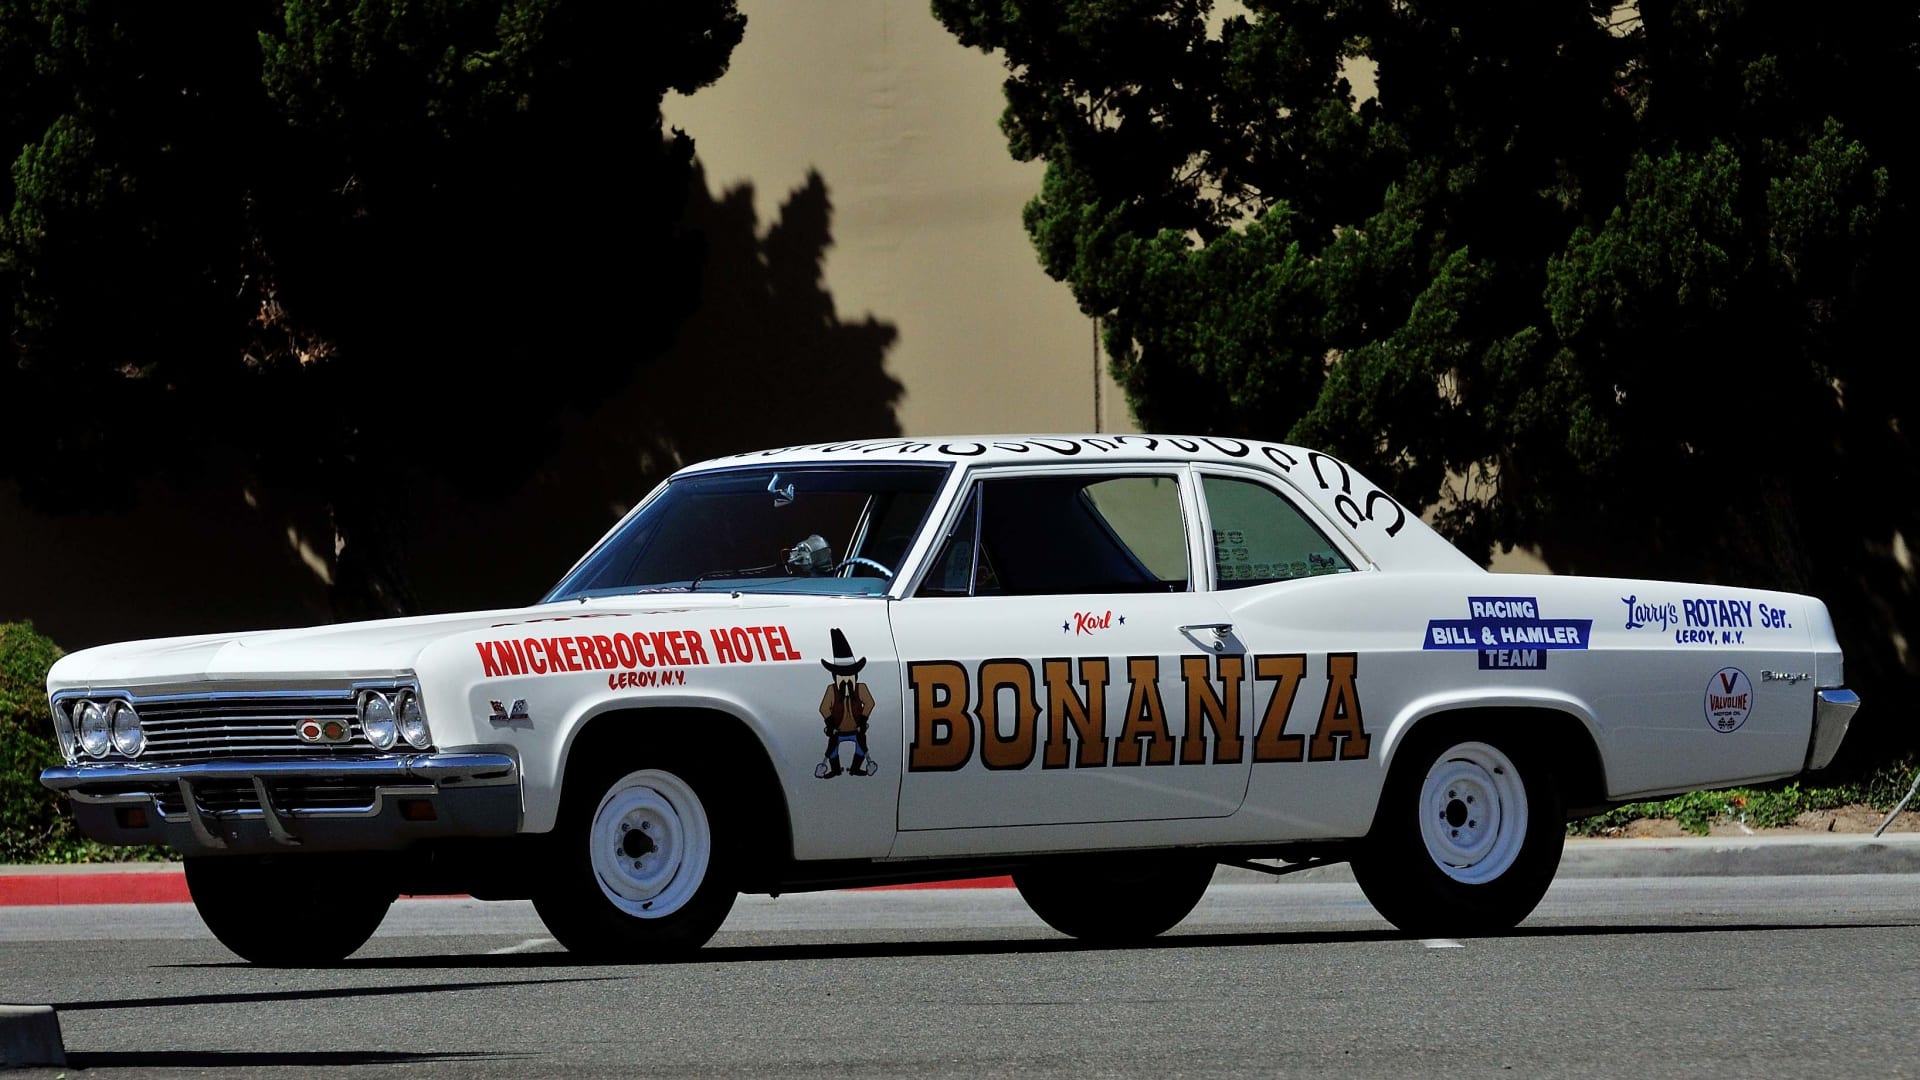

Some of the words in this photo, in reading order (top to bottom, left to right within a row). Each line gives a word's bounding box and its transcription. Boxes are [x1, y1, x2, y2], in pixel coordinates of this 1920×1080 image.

[1472, 601, 1535, 618] RACING
[1621, 595, 1678, 632] Larry's
[1683, 599, 1753, 627] ROTARY
[1758, 603, 1792, 628] Ser.
[1074, 610, 1111, 636] Karl
[1432, 627, 1476, 645] BILL
[1481, 626, 1498, 645] &
[1501, 627, 1580, 644] HAMLER
[1675, 629, 1718, 645] LEROY,
[1722, 630, 1745, 645] N.Y.
[475, 630, 709, 677] KNICKERBOCKER
[710, 625, 801, 664] HOTEL
[1485, 650, 1537, 667] TEAM
[1710, 693, 1747, 711] VALVOLINE
[907, 652, 1371, 772] BONANZA
